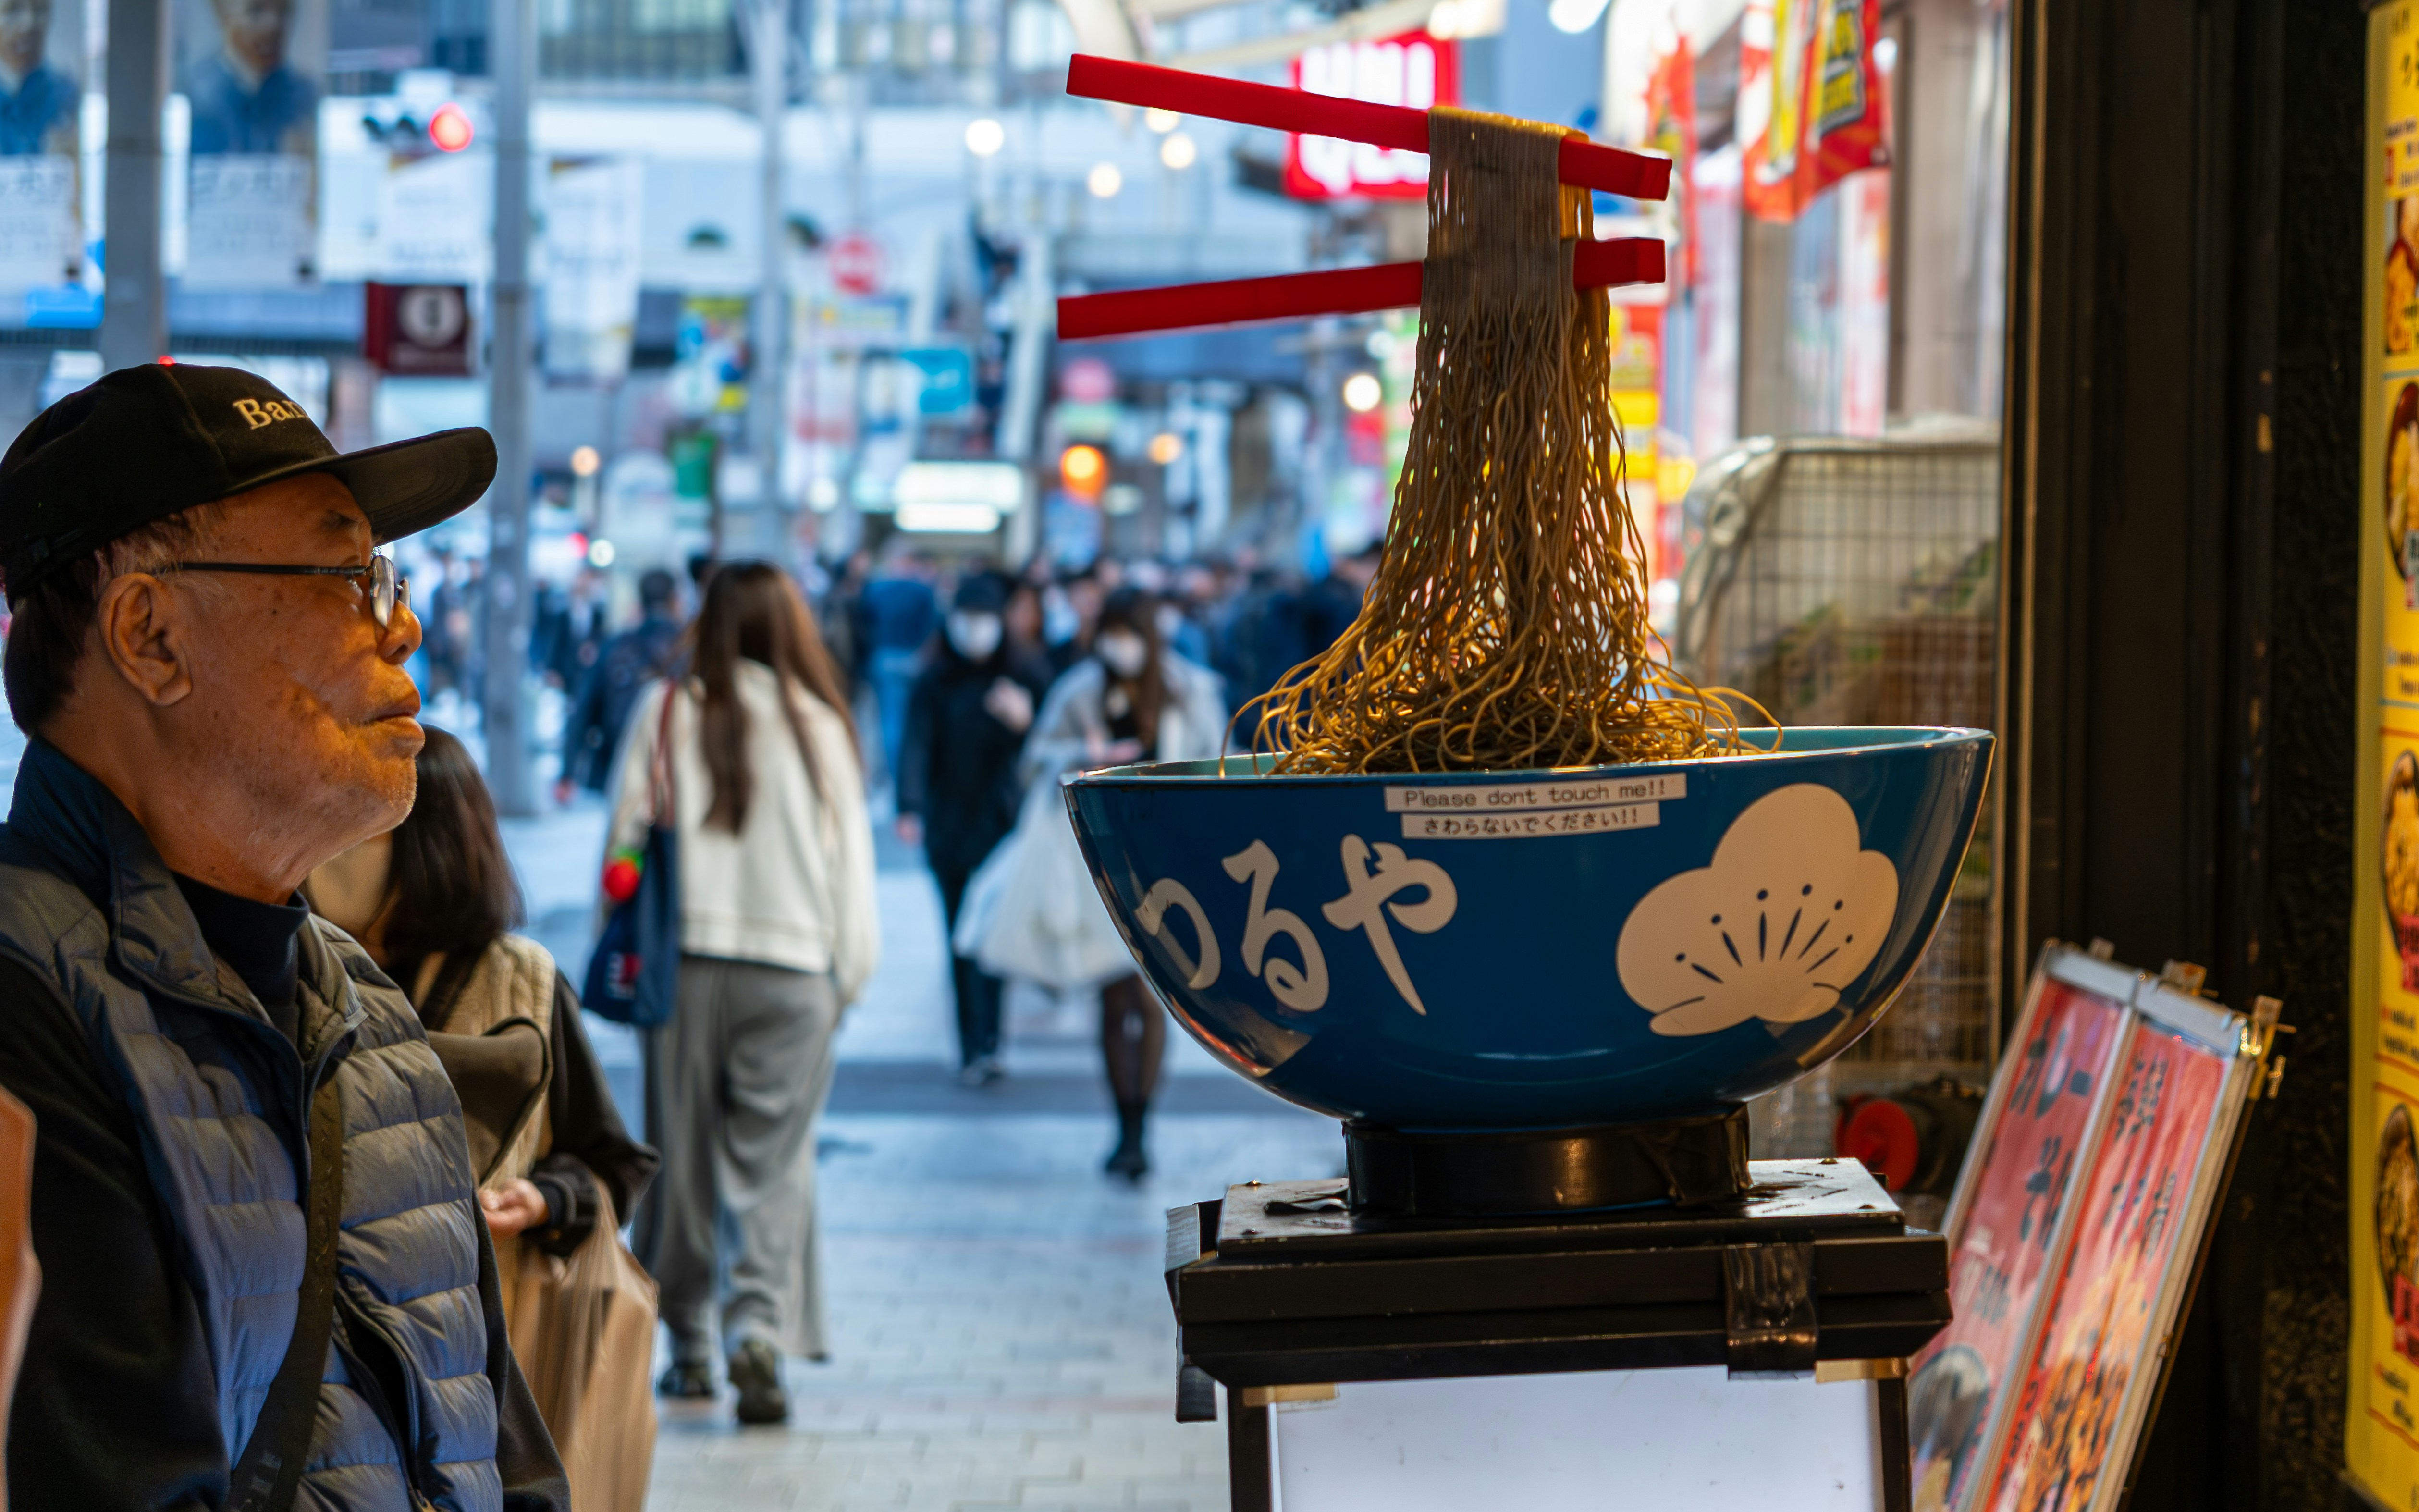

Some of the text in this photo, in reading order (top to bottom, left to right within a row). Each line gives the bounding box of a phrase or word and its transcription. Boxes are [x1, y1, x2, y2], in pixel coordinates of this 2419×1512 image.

[1404, 778, 1665, 807] Please dont touch me!!
[1424, 807, 1637, 835] さわらないでください!!
[1134, 833, 1458, 1016] つるや
